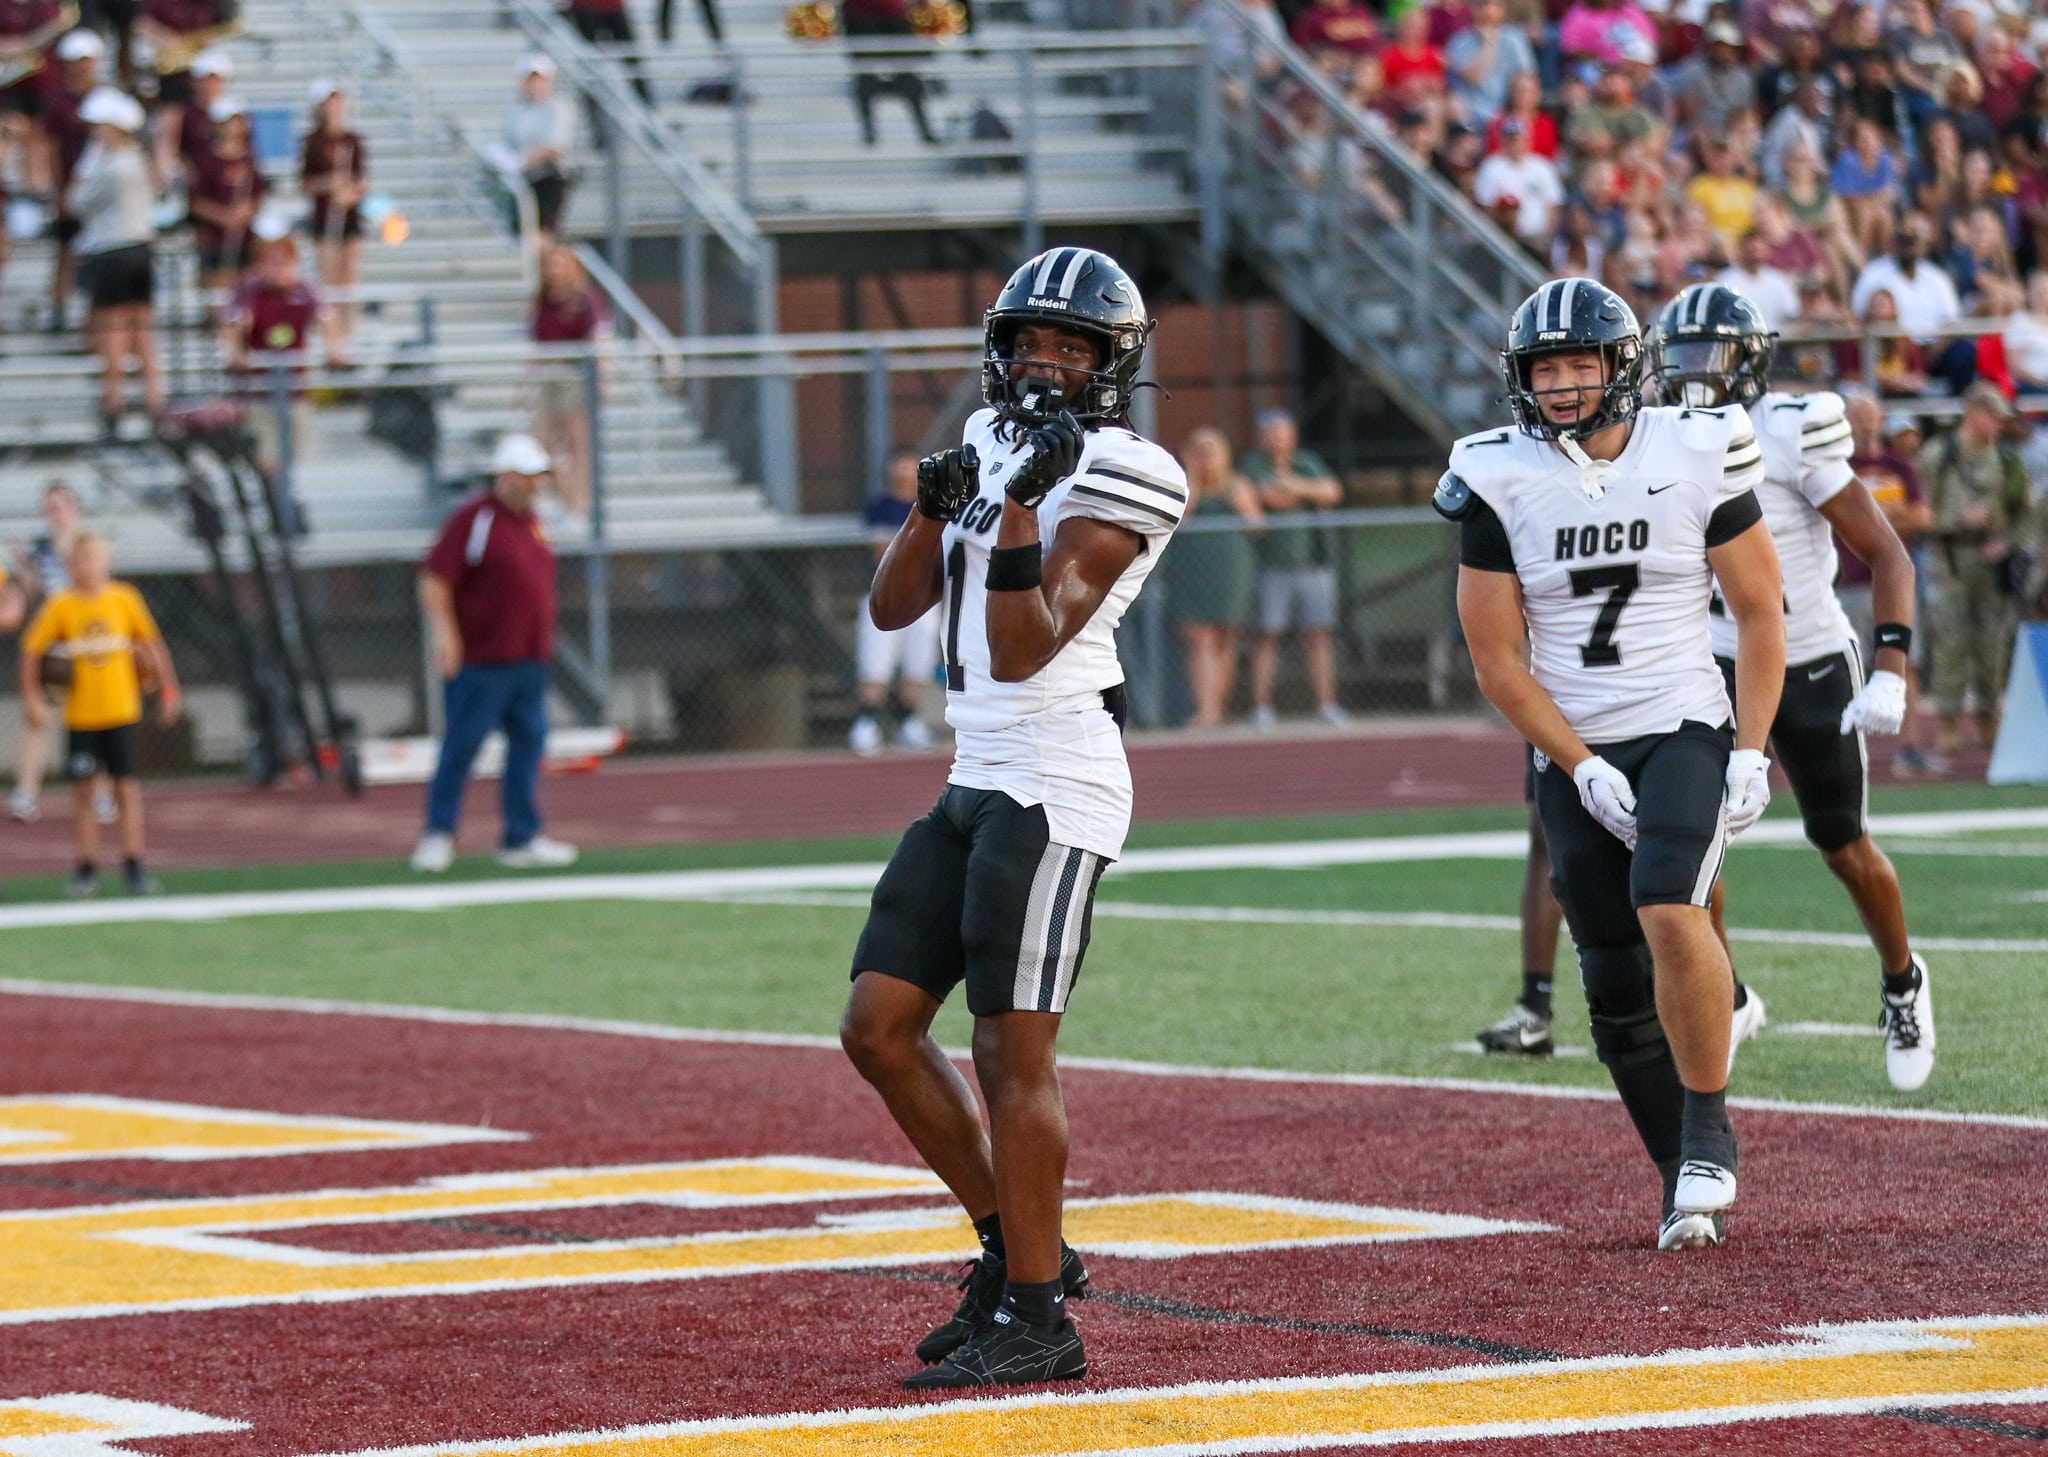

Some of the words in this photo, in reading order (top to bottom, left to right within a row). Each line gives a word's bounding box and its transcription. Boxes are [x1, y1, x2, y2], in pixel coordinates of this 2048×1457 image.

[1027, 296, 1068, 310] Riddell
[950, 496, 1003, 535] CO
[1554, 518, 1650, 562] HOCO
[947, 541, 966, 693] 1
[1567, 561, 1641, 668] 7
